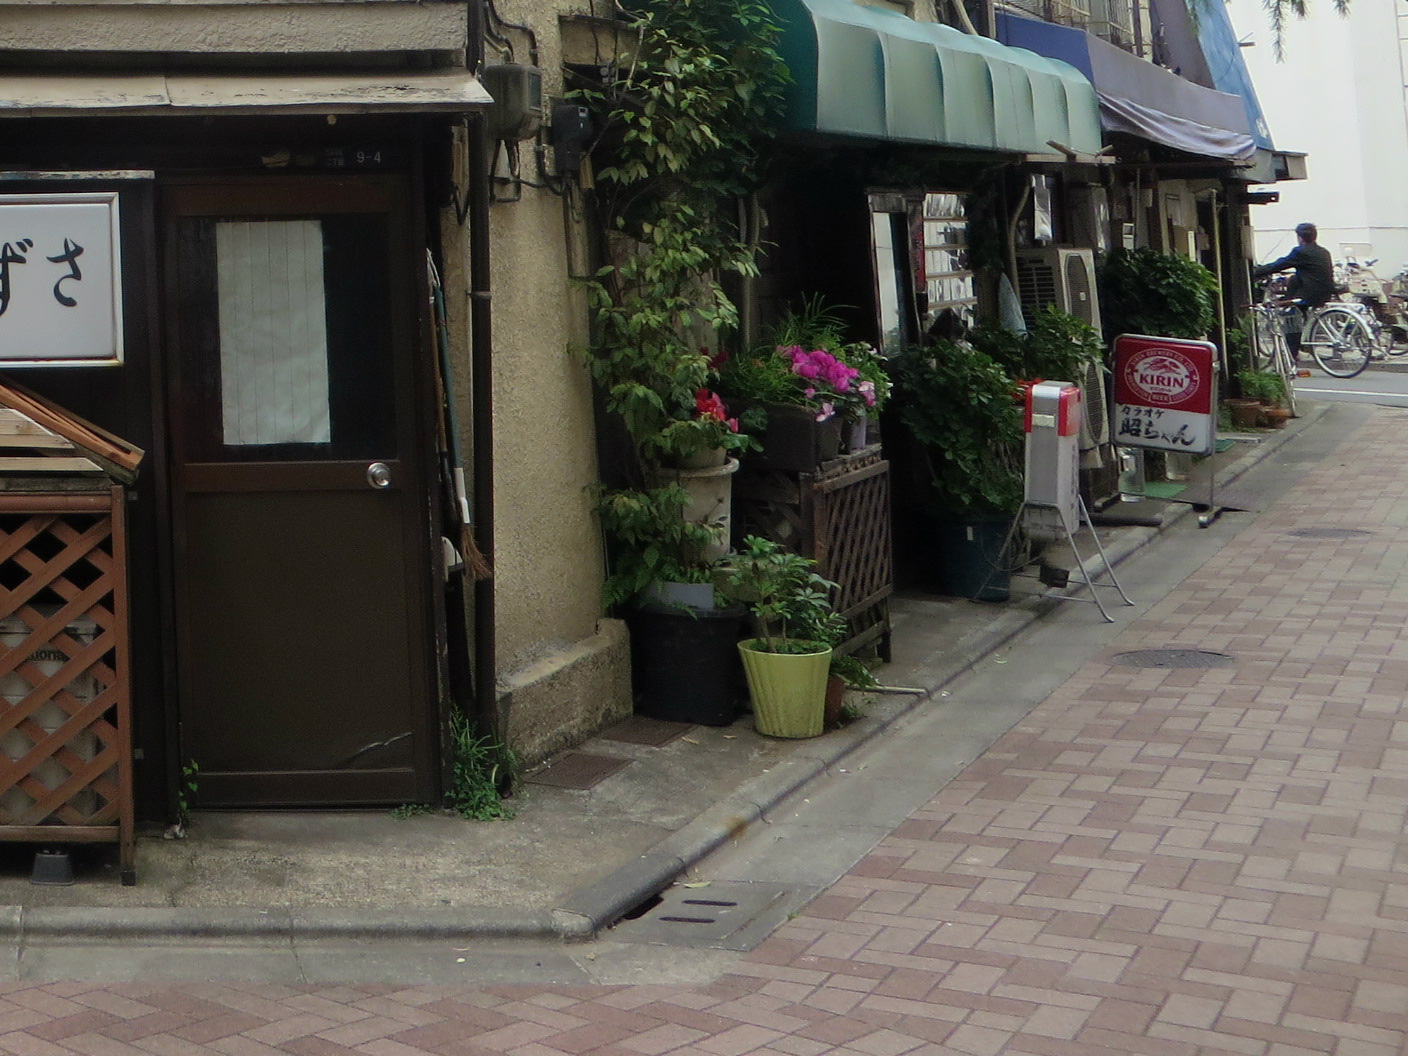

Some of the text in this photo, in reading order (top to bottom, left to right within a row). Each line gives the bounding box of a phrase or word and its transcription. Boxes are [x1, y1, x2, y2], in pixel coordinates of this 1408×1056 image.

[356, 151, 382, 163] 9-4
[1139, 373, 1185, 389] KIRIN
[1121, 405, 1165, 419] カラオケ
